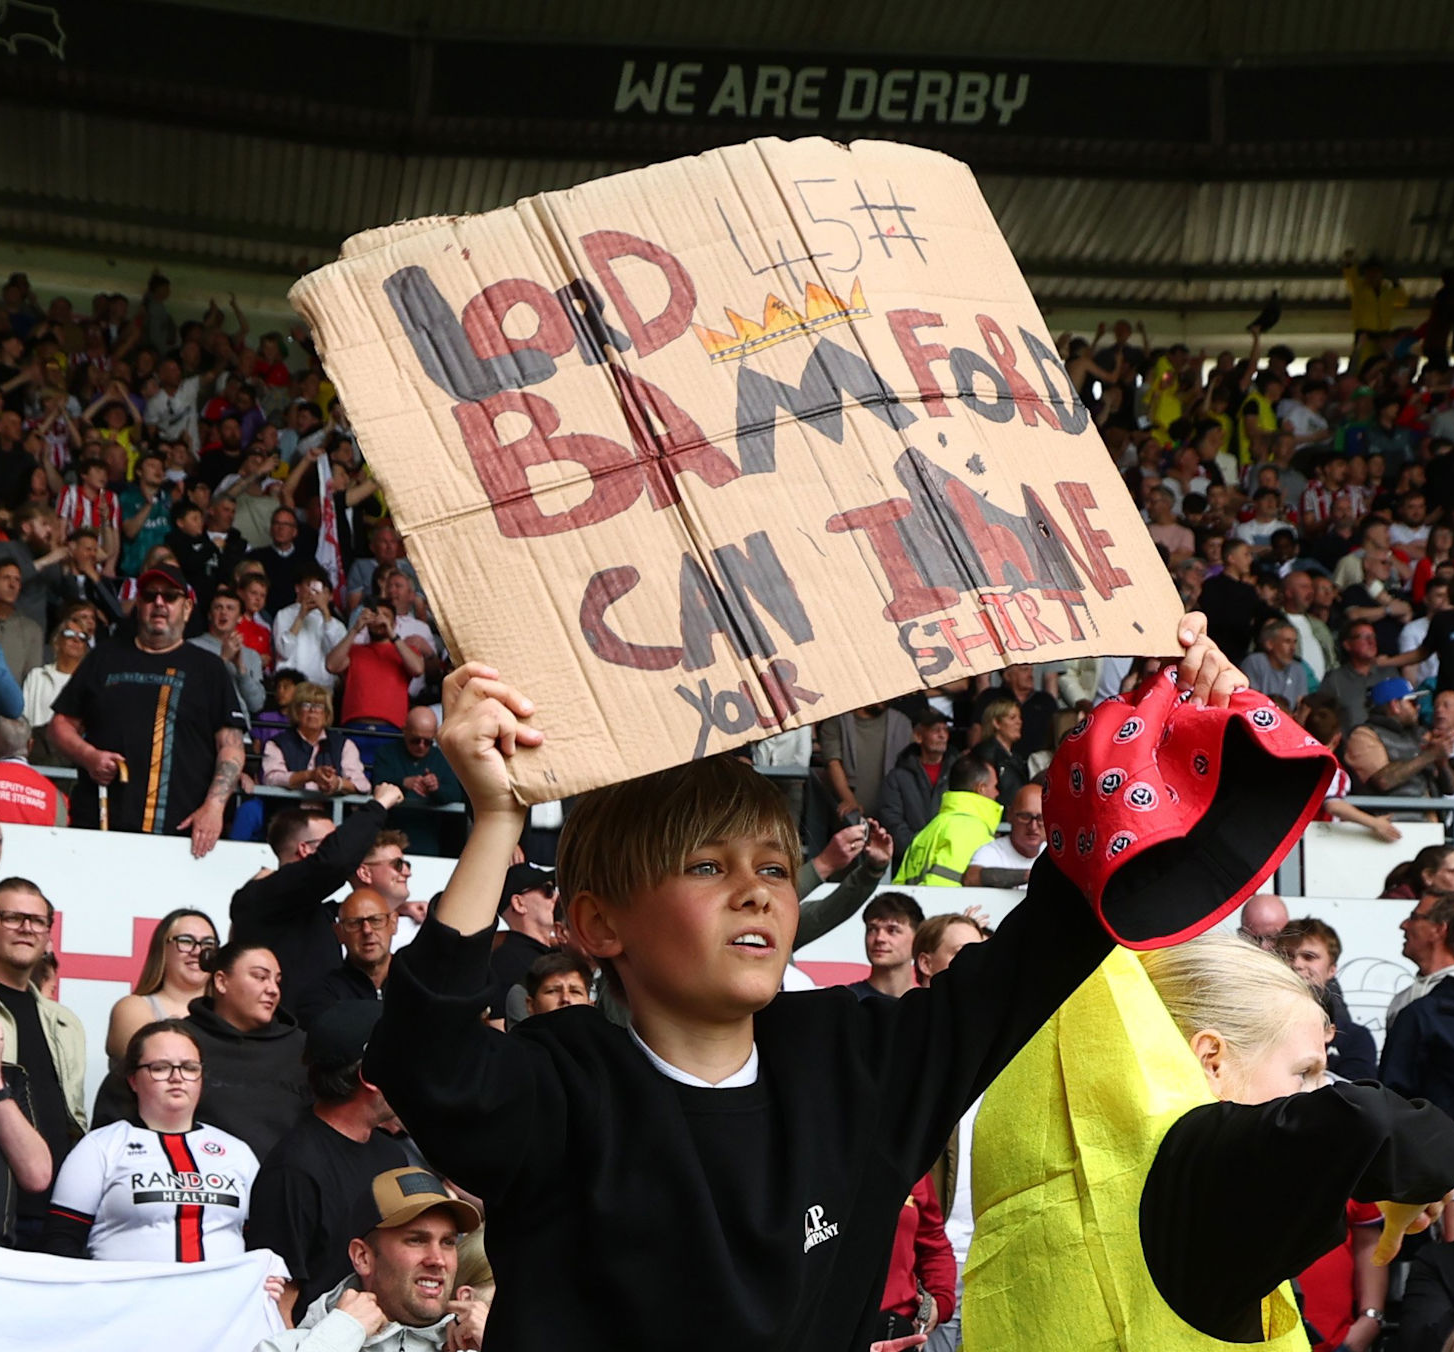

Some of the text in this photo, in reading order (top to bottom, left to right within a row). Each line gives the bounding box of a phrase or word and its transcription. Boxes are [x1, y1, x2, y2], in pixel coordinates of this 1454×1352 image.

[614, 60, 1031, 127] WE ARE DERBY
[579, 530, 816, 673] CAN
[674, 588, 1087, 760] YOUR SHIRT
[11, 792, 47, 811] STEWARD
[25, 786, 47, 800] CHIEF
[131, 1171, 240, 1193] RANDOX
[162, 1191, 219, 1204] HEALTH
